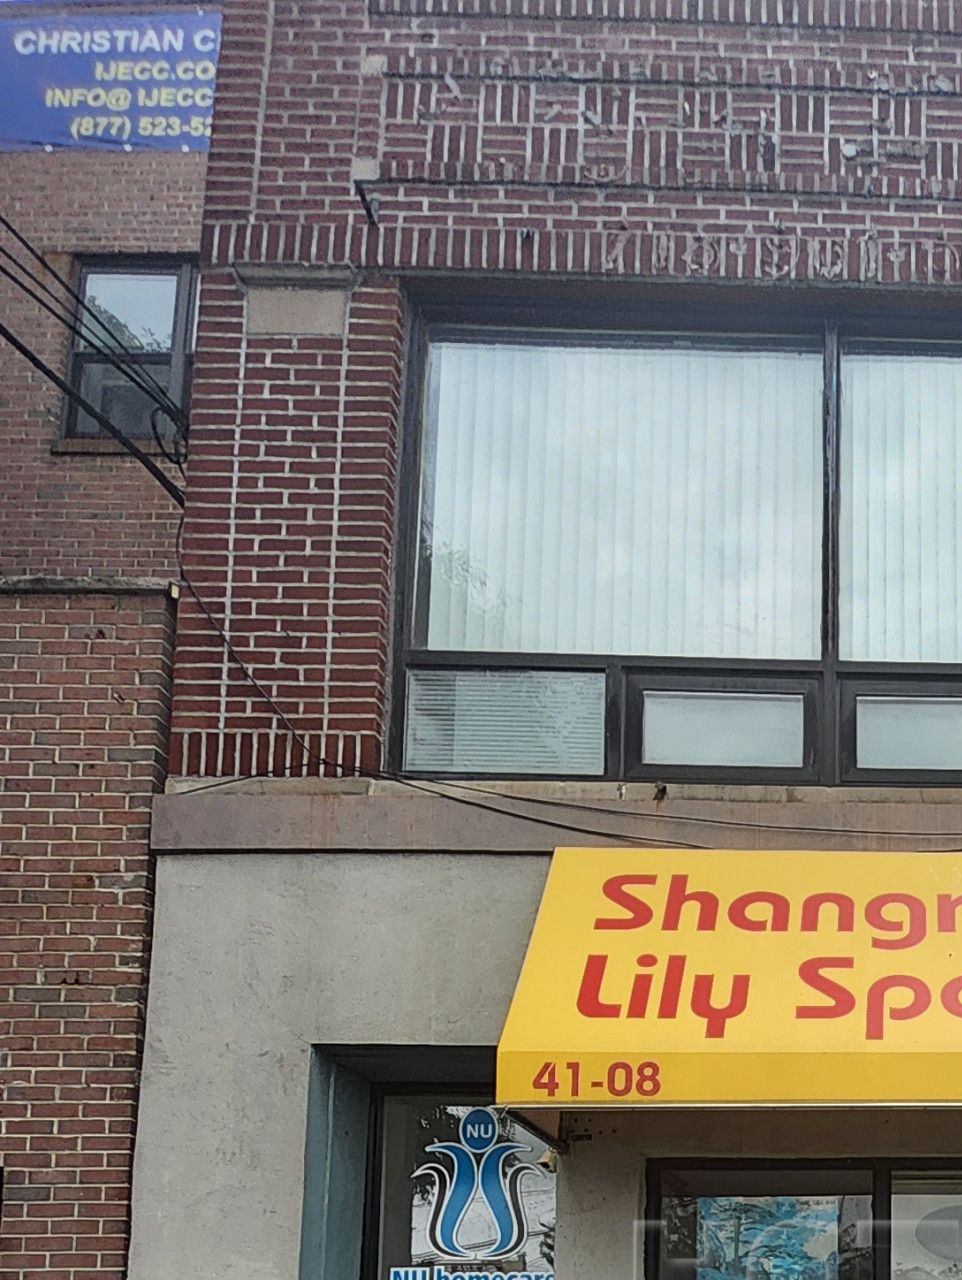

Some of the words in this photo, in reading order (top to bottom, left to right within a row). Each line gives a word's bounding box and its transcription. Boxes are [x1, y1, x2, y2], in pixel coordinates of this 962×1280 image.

[13, 29, 184, 54] CHRISTIAN
[45, 87, 131, 110] INFO@
[70, 116, 131, 140] (877)
[576, 953, 751, 1039] Lily
[532, 1061, 662, 1097] 41-08
[466, 1124, 492, 1139] NU
